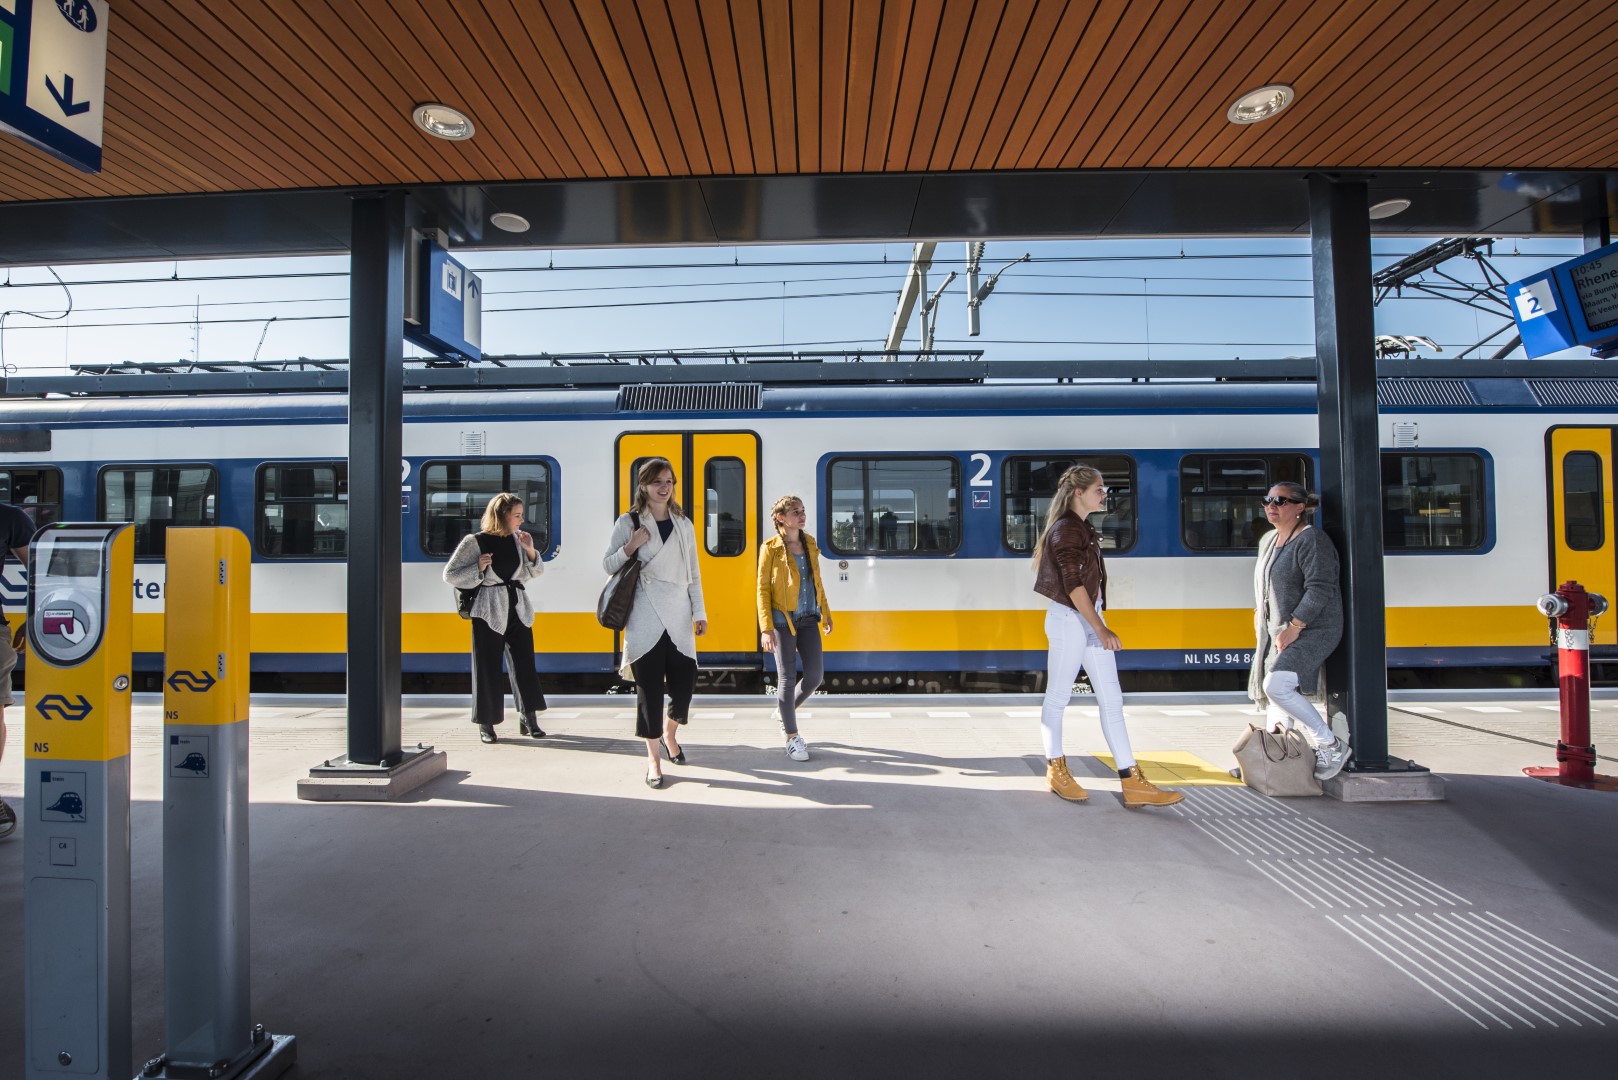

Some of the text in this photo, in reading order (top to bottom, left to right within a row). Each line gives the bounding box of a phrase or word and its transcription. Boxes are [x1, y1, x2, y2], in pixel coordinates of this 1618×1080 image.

[1575, 259, 1602, 276] 10:45
[1577, 268, 1618, 290] Rhene
[1582, 292, 1593, 300] via
[1527, 296, 1542, 314] 2
[1587, 303, 1618, 318] en Veen
[970, 453, 993, 487] 2
[133, 578, 165, 599] te
[1184, 653, 1201, 664] NL
[1204, 653, 1220, 664] NS
[1225, 653, 1240, 664] 94
[165, 710, 179, 720] NS
[34, 742, 49, 753] NS
